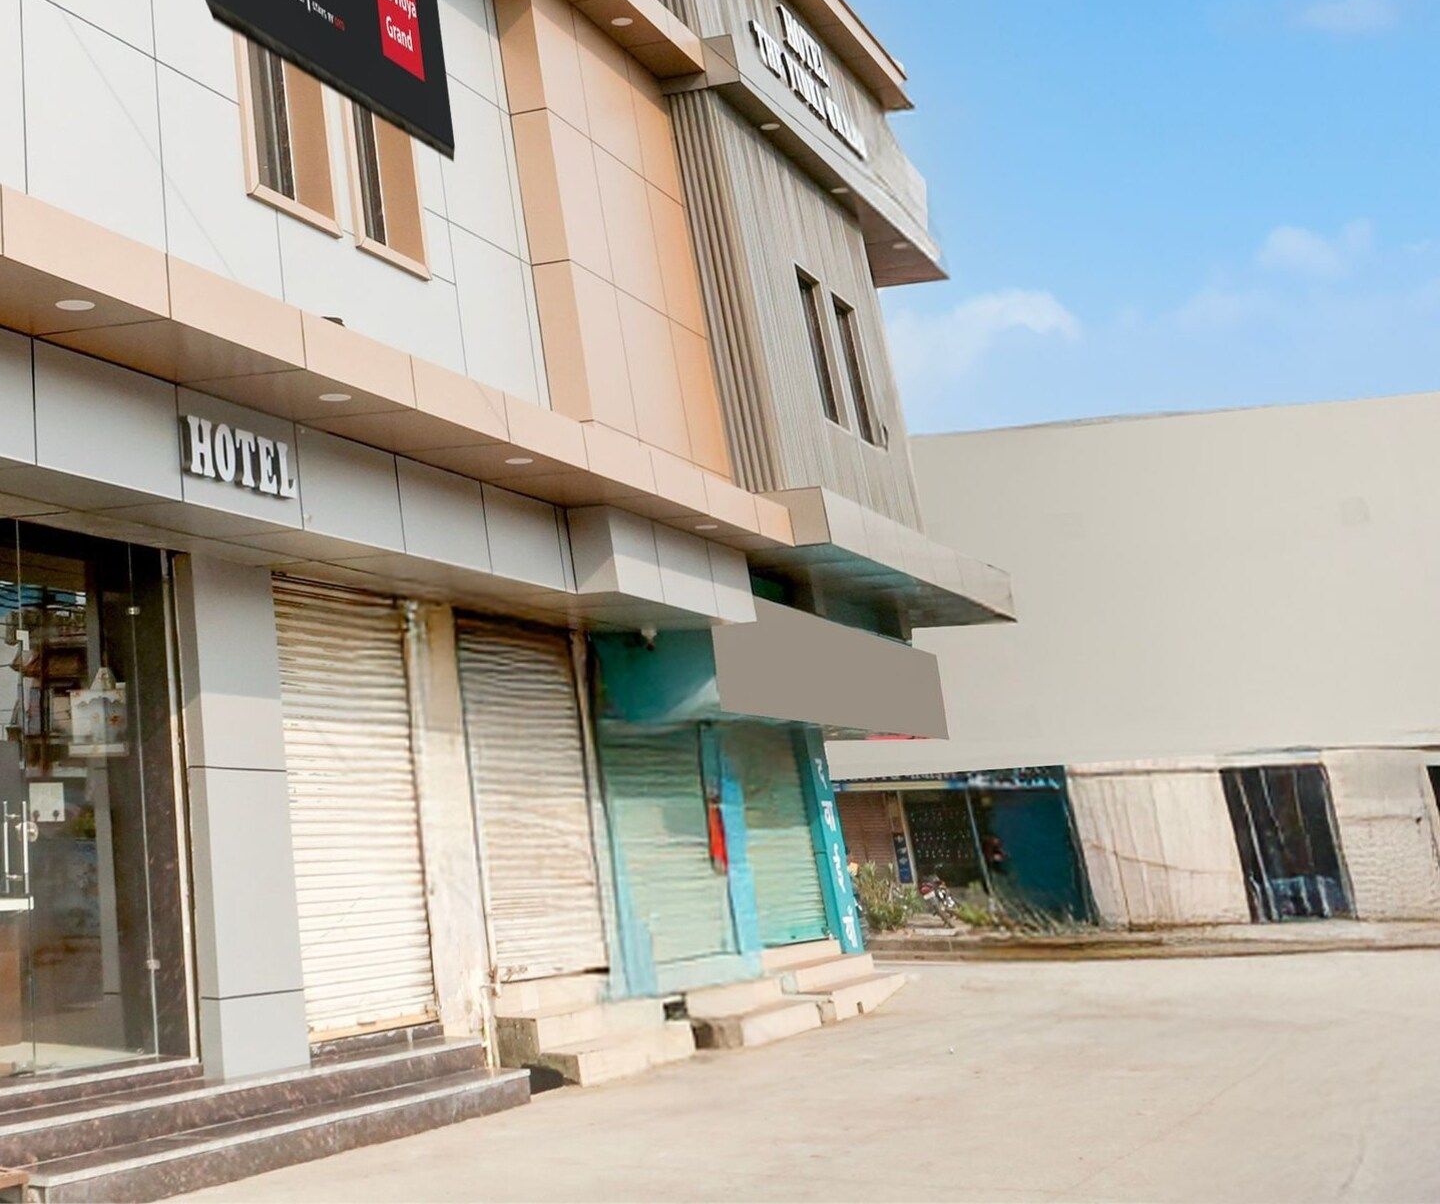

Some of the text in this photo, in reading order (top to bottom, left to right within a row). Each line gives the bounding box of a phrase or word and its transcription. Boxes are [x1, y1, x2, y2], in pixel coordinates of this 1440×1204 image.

[385, 16, 414, 52] Grand
[779, 4, 830, 87] HOTEL
[186, 414, 298, 500] HOTEL
